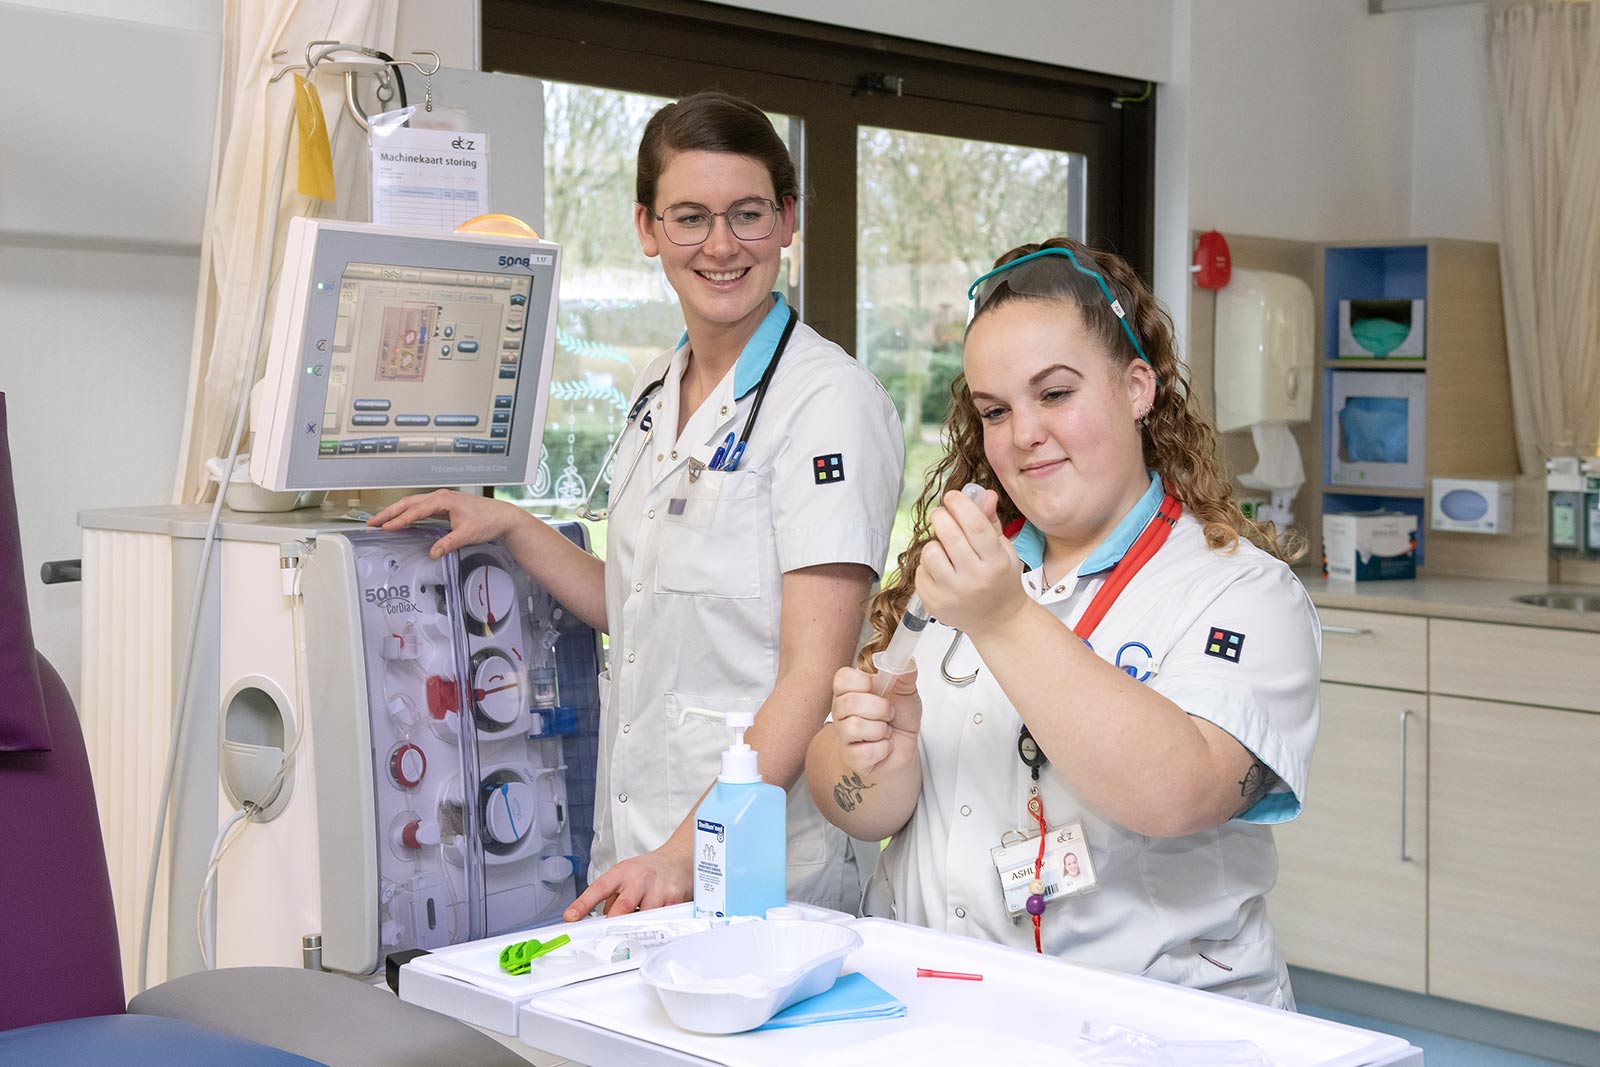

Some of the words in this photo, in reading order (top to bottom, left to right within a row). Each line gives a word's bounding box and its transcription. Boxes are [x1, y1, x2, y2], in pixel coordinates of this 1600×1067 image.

[380, 153, 443, 165] Machinekaart
[445, 159, 477, 169] storing
[498, 256, 530, 267] 5008
[365, 585, 410, 603] 5008
